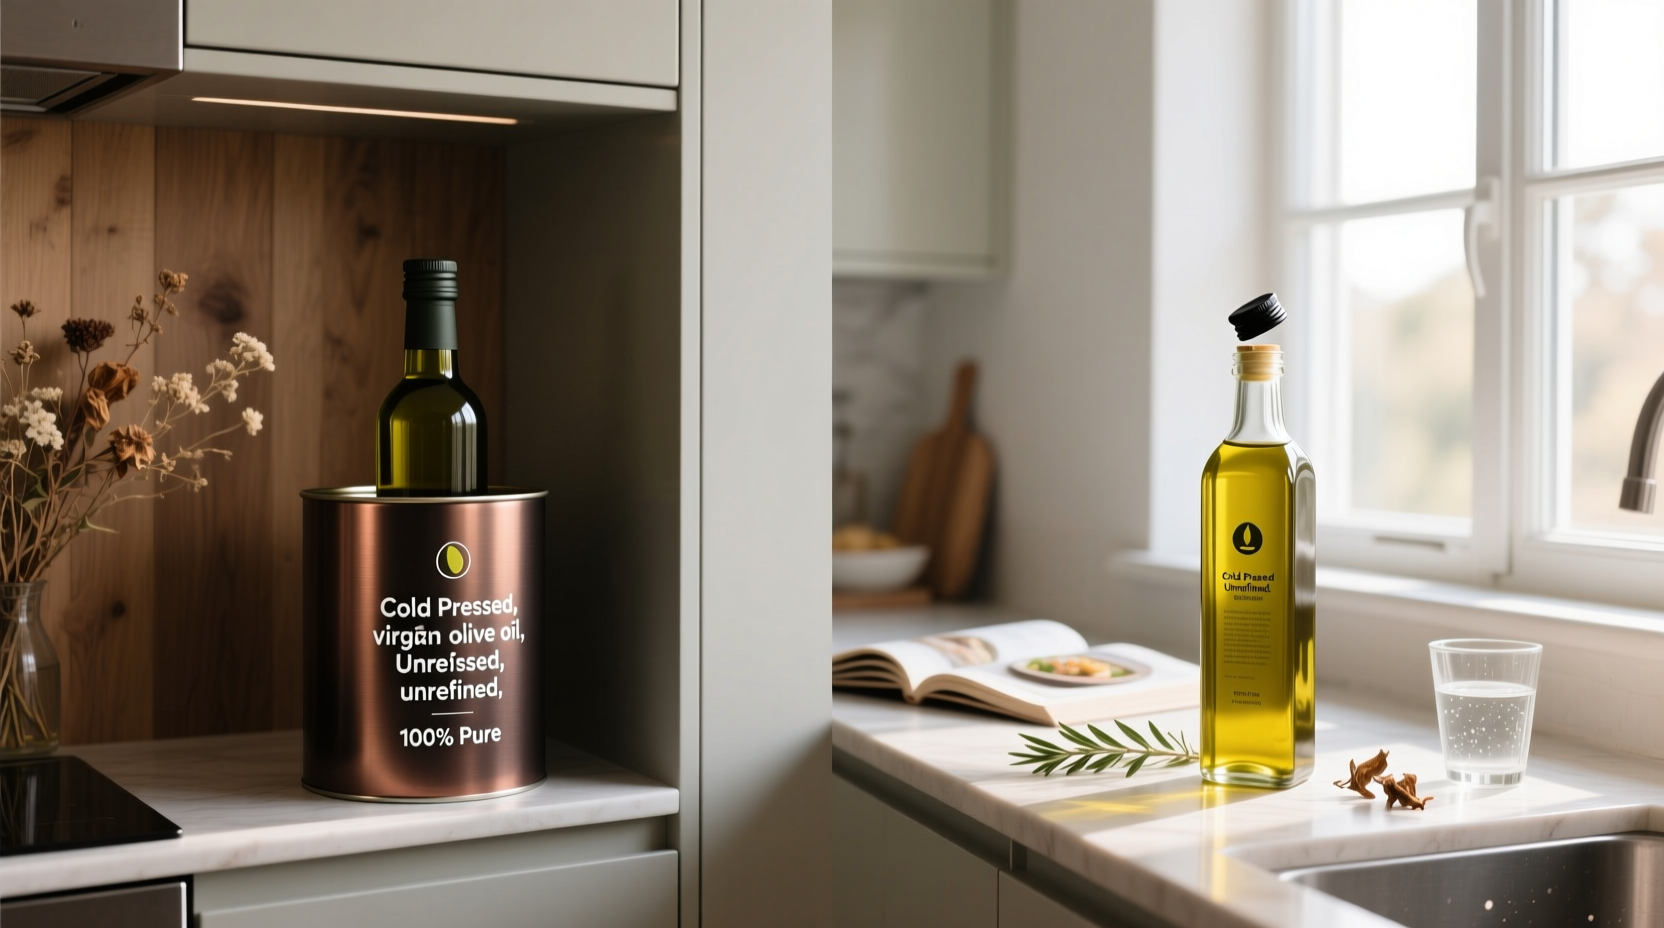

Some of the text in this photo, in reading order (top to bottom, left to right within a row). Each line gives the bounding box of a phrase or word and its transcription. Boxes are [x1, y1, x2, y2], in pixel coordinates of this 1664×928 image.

[380, 593, 518, 618] Cold Pressed,
[449, 622, 496, 645] olive
[500, 619, 525, 644] oil,
[400, 676, 503, 702] unrefined,
[399, 726, 502, 748] 100% Pure
